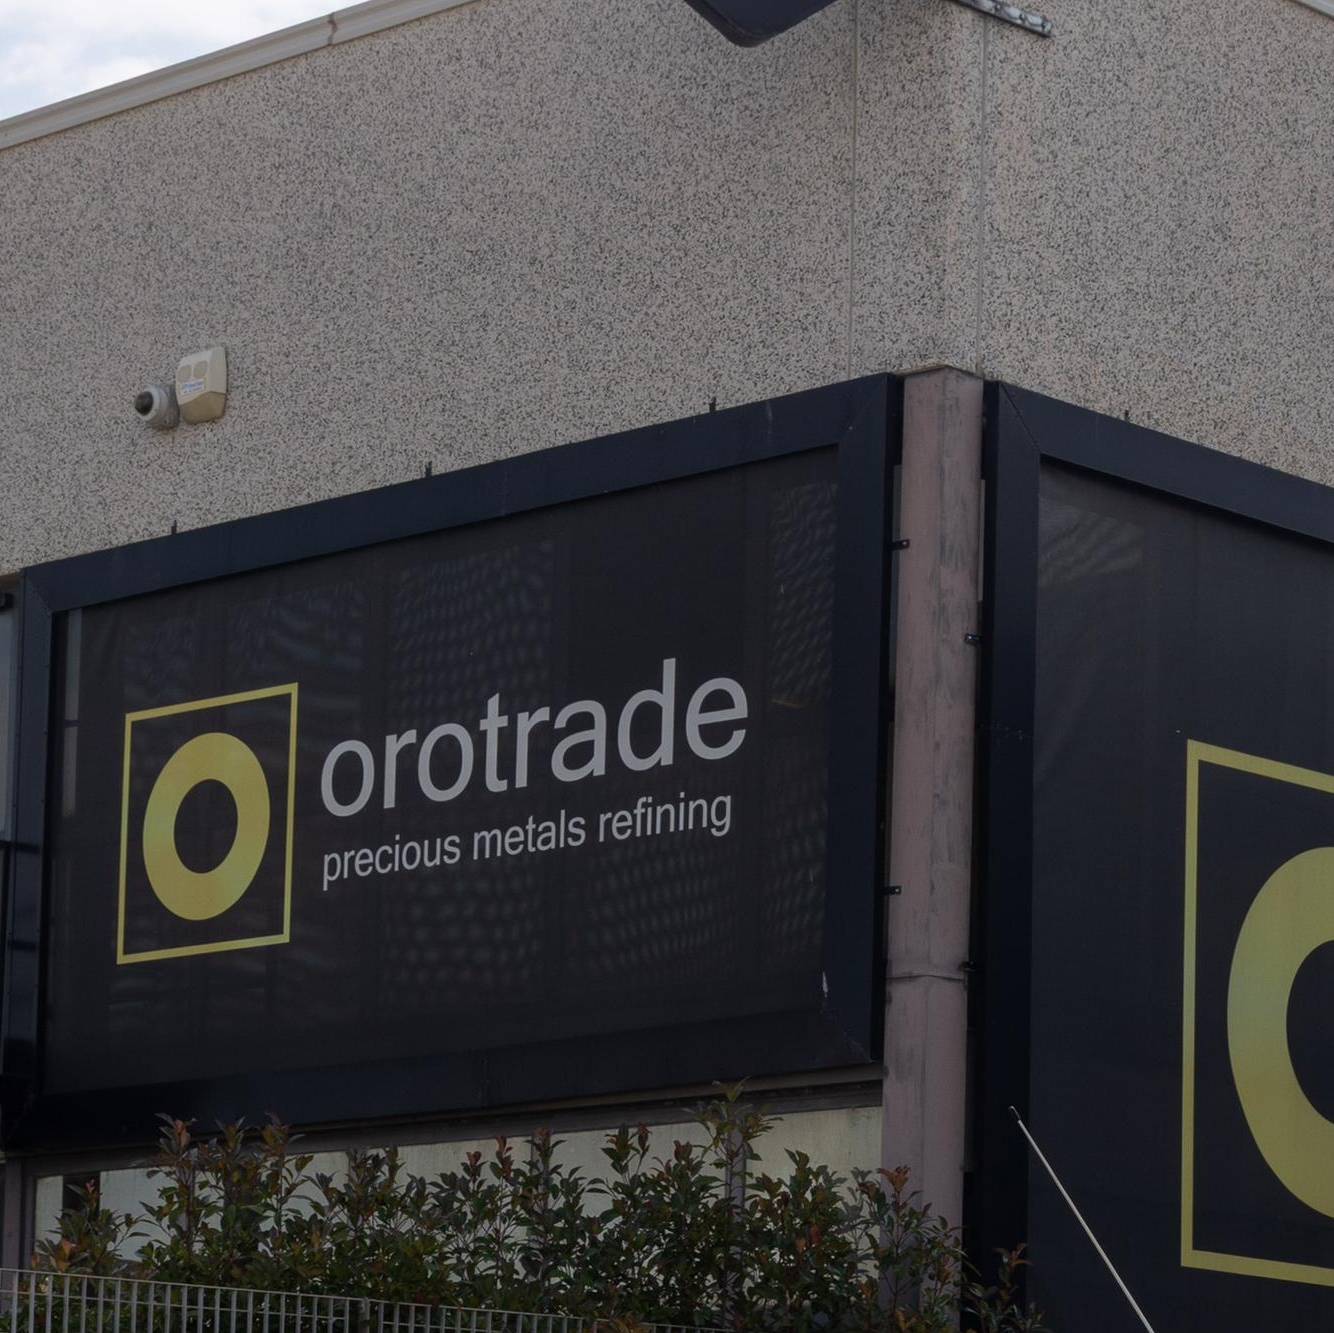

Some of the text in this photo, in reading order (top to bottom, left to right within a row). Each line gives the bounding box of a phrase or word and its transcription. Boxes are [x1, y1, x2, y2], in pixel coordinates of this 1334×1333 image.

[320, 658, 748, 818] orotrade
[323, 791, 732, 891] precious metals refining
